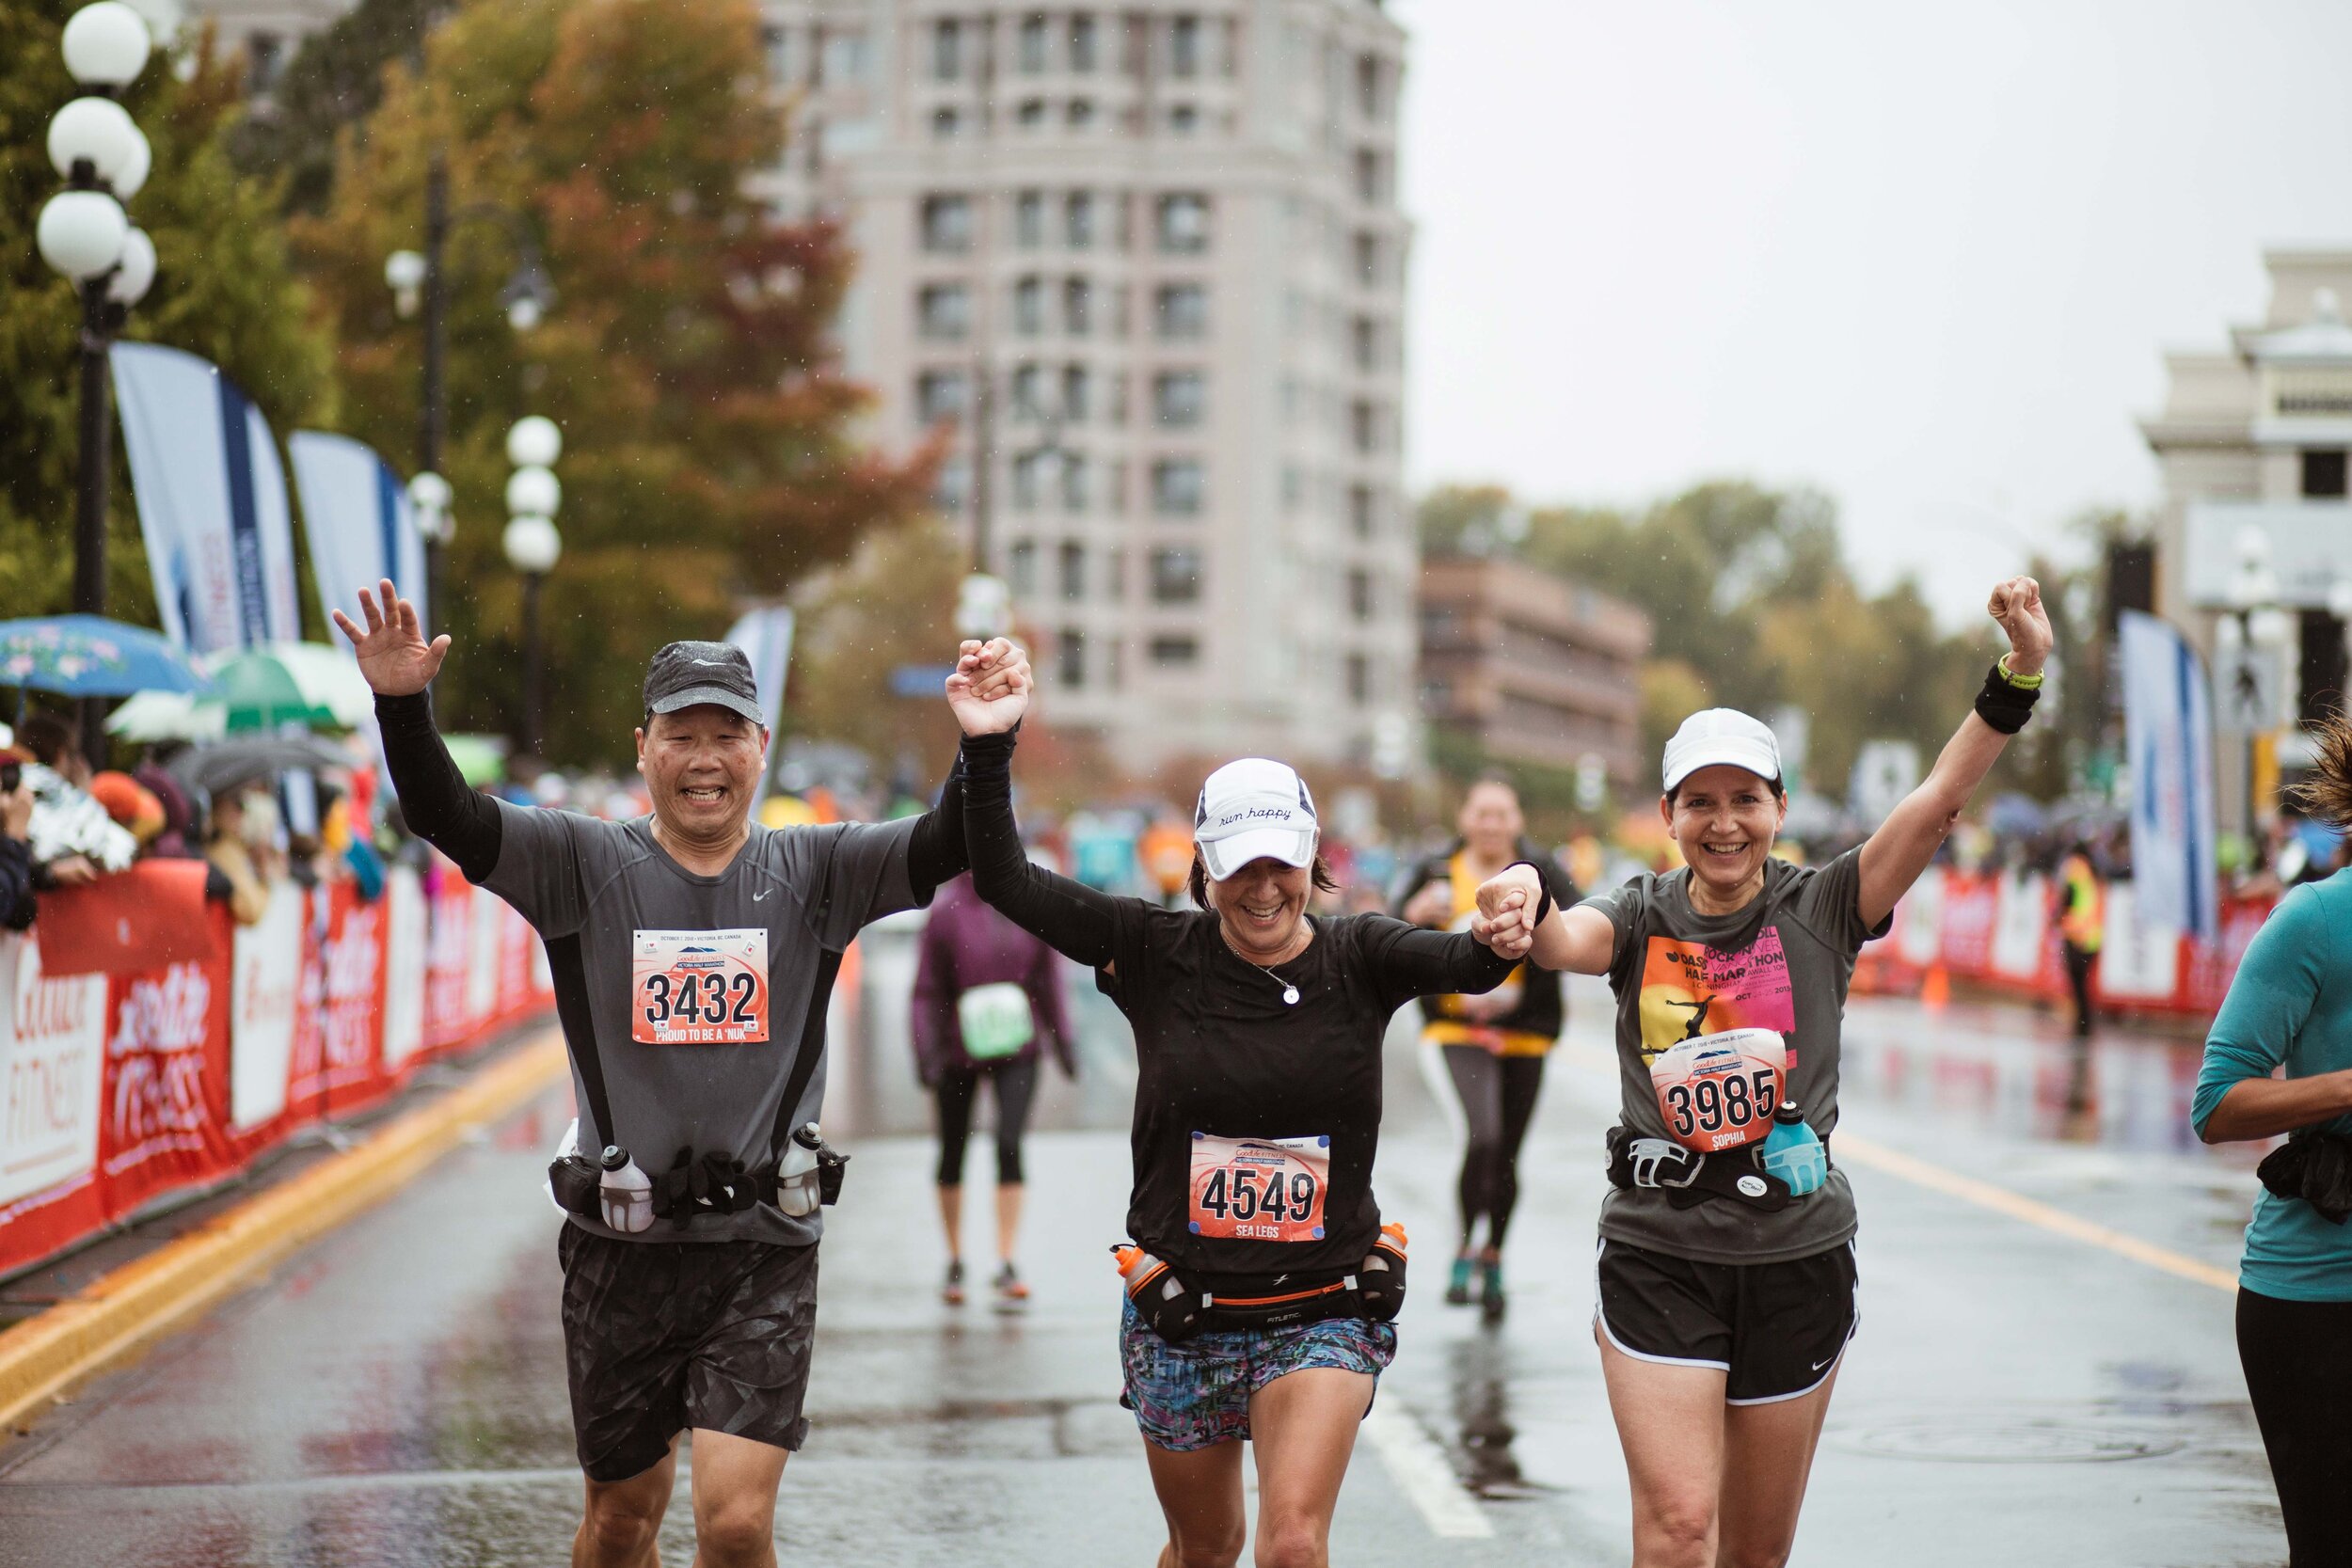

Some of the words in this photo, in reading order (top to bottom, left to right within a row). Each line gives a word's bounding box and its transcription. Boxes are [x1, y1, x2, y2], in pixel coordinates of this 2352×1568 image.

[1219, 813, 1243, 827] run
[1247, 807, 1291, 820] happy
[1757, 926, 1776, 940] OLL
[1680, 952, 1708, 971] OASS
[646, 973, 756, 1025] 3432
[1735, 992, 1752, 1002] OCT
[1774, 985, 1792, 994] 2015
[656, 1029, 686, 1041] PROUD
[688, 1029, 700, 1040] TO
[702, 1028, 715, 1040] BE
[716, 1028, 723, 1040] A
[1667, 1069, 1775, 1137] 3985
[1712, 1130, 1745, 1148] SOPHIA
[1201, 1168, 1314, 1222] 4549
[1236, 1225, 1254, 1236] SEA
[1256, 1227, 1279, 1238] LEGS
